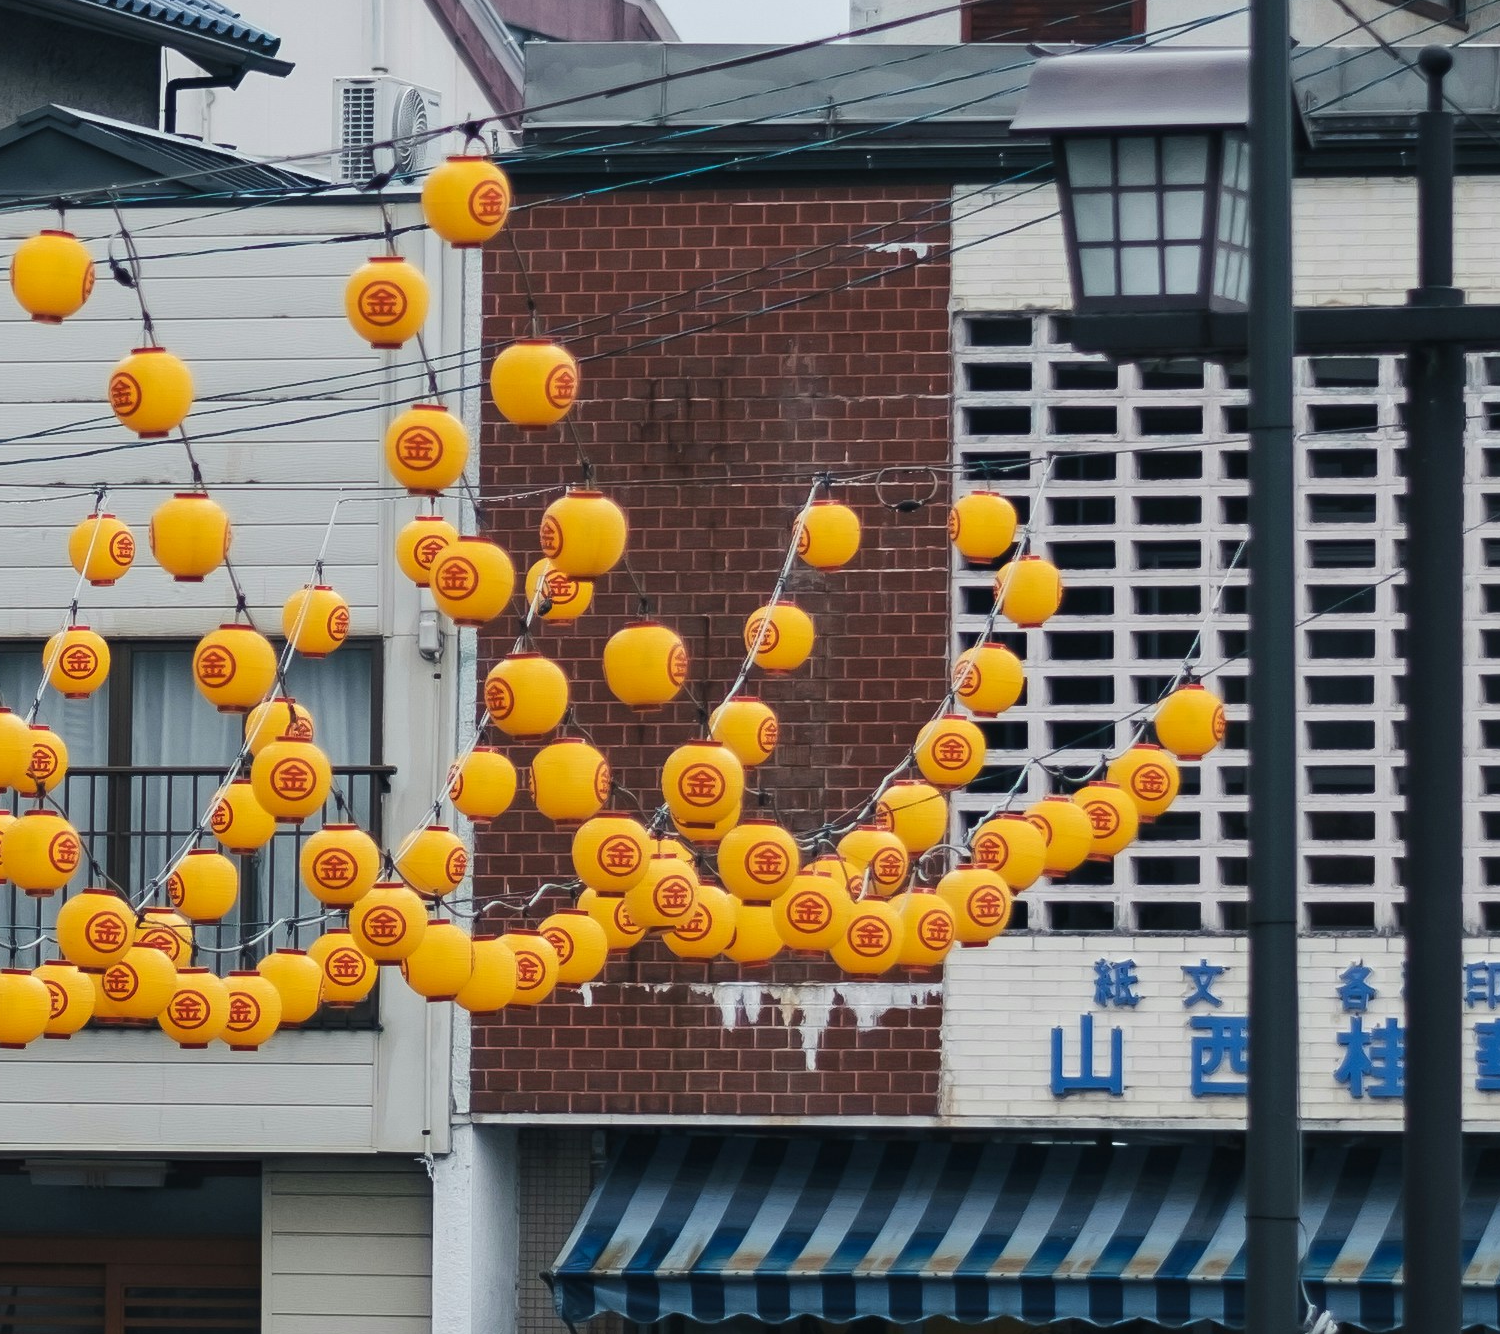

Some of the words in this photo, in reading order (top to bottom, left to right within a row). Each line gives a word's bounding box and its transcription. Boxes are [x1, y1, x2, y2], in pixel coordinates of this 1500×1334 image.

[478, 189, 504, 215] 金
[368, 289, 397, 316] 金
[113, 380, 133, 409] 金
[555, 373, 576, 399] 金
[402, 435, 432, 461] 金
[442, 565, 470, 590] 金
[66, 650, 93, 674] 金
[201, 651, 227, 679] 金
[486, 685, 507, 712] 金
[33, 751, 51, 774] 金
[939, 738, 965, 763] 金
[280, 767, 307, 792] 金
[688, 773, 716, 798] 金
[1140, 769, 1164, 796] 金
[1087, 808, 1112, 832] 金
[55, 839, 77, 866] 金
[607, 844, 634, 868] 金
[978, 836, 1001, 861] 金
[321, 857, 349, 880] 金
[755, 852, 781, 875] 金
[879, 851, 902, 879] 金
[661, 886, 689, 910] 金
[974, 892, 1001, 918] 金
[796, 901, 822, 925] 金
[95, 921, 121, 944] 金
[371, 914, 397, 939] 金
[855, 920, 884, 947] 金
[925, 916, 948, 943] 金
[333, 954, 359, 978] 金
[518, 958, 538, 982] 金
[108, 970, 130, 994] 金
[176, 997, 202, 1021] 金
[231, 1001, 253, 1024] 金
